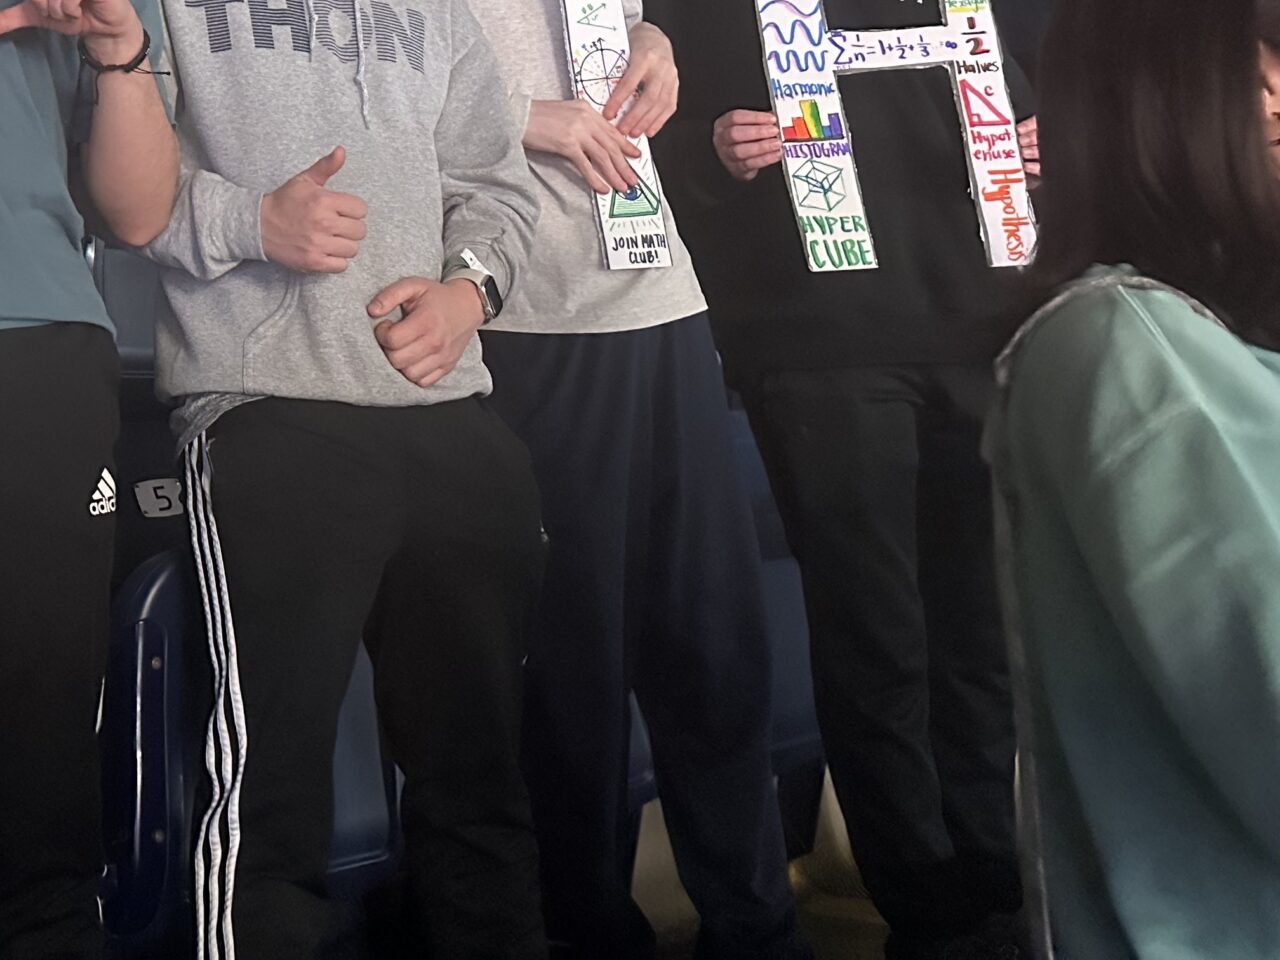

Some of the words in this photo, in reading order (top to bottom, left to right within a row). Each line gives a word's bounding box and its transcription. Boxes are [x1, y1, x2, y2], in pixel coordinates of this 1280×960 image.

[956, 59, 1000, 75] Halves
[770, 77, 836, 100] Harmonic
[972, 148, 1016, 162] enuse
[799, 214, 866, 236] HYPER
[981, 167, 1030, 262] Hypothesis
[612, 236, 639, 252] JOIN
[641, 233, 667, 249] MATH
[809, 238, 873, 269] CUBE
[628, 249, 662, 265] CLUB!
[152, 485, 173, 511] 5
